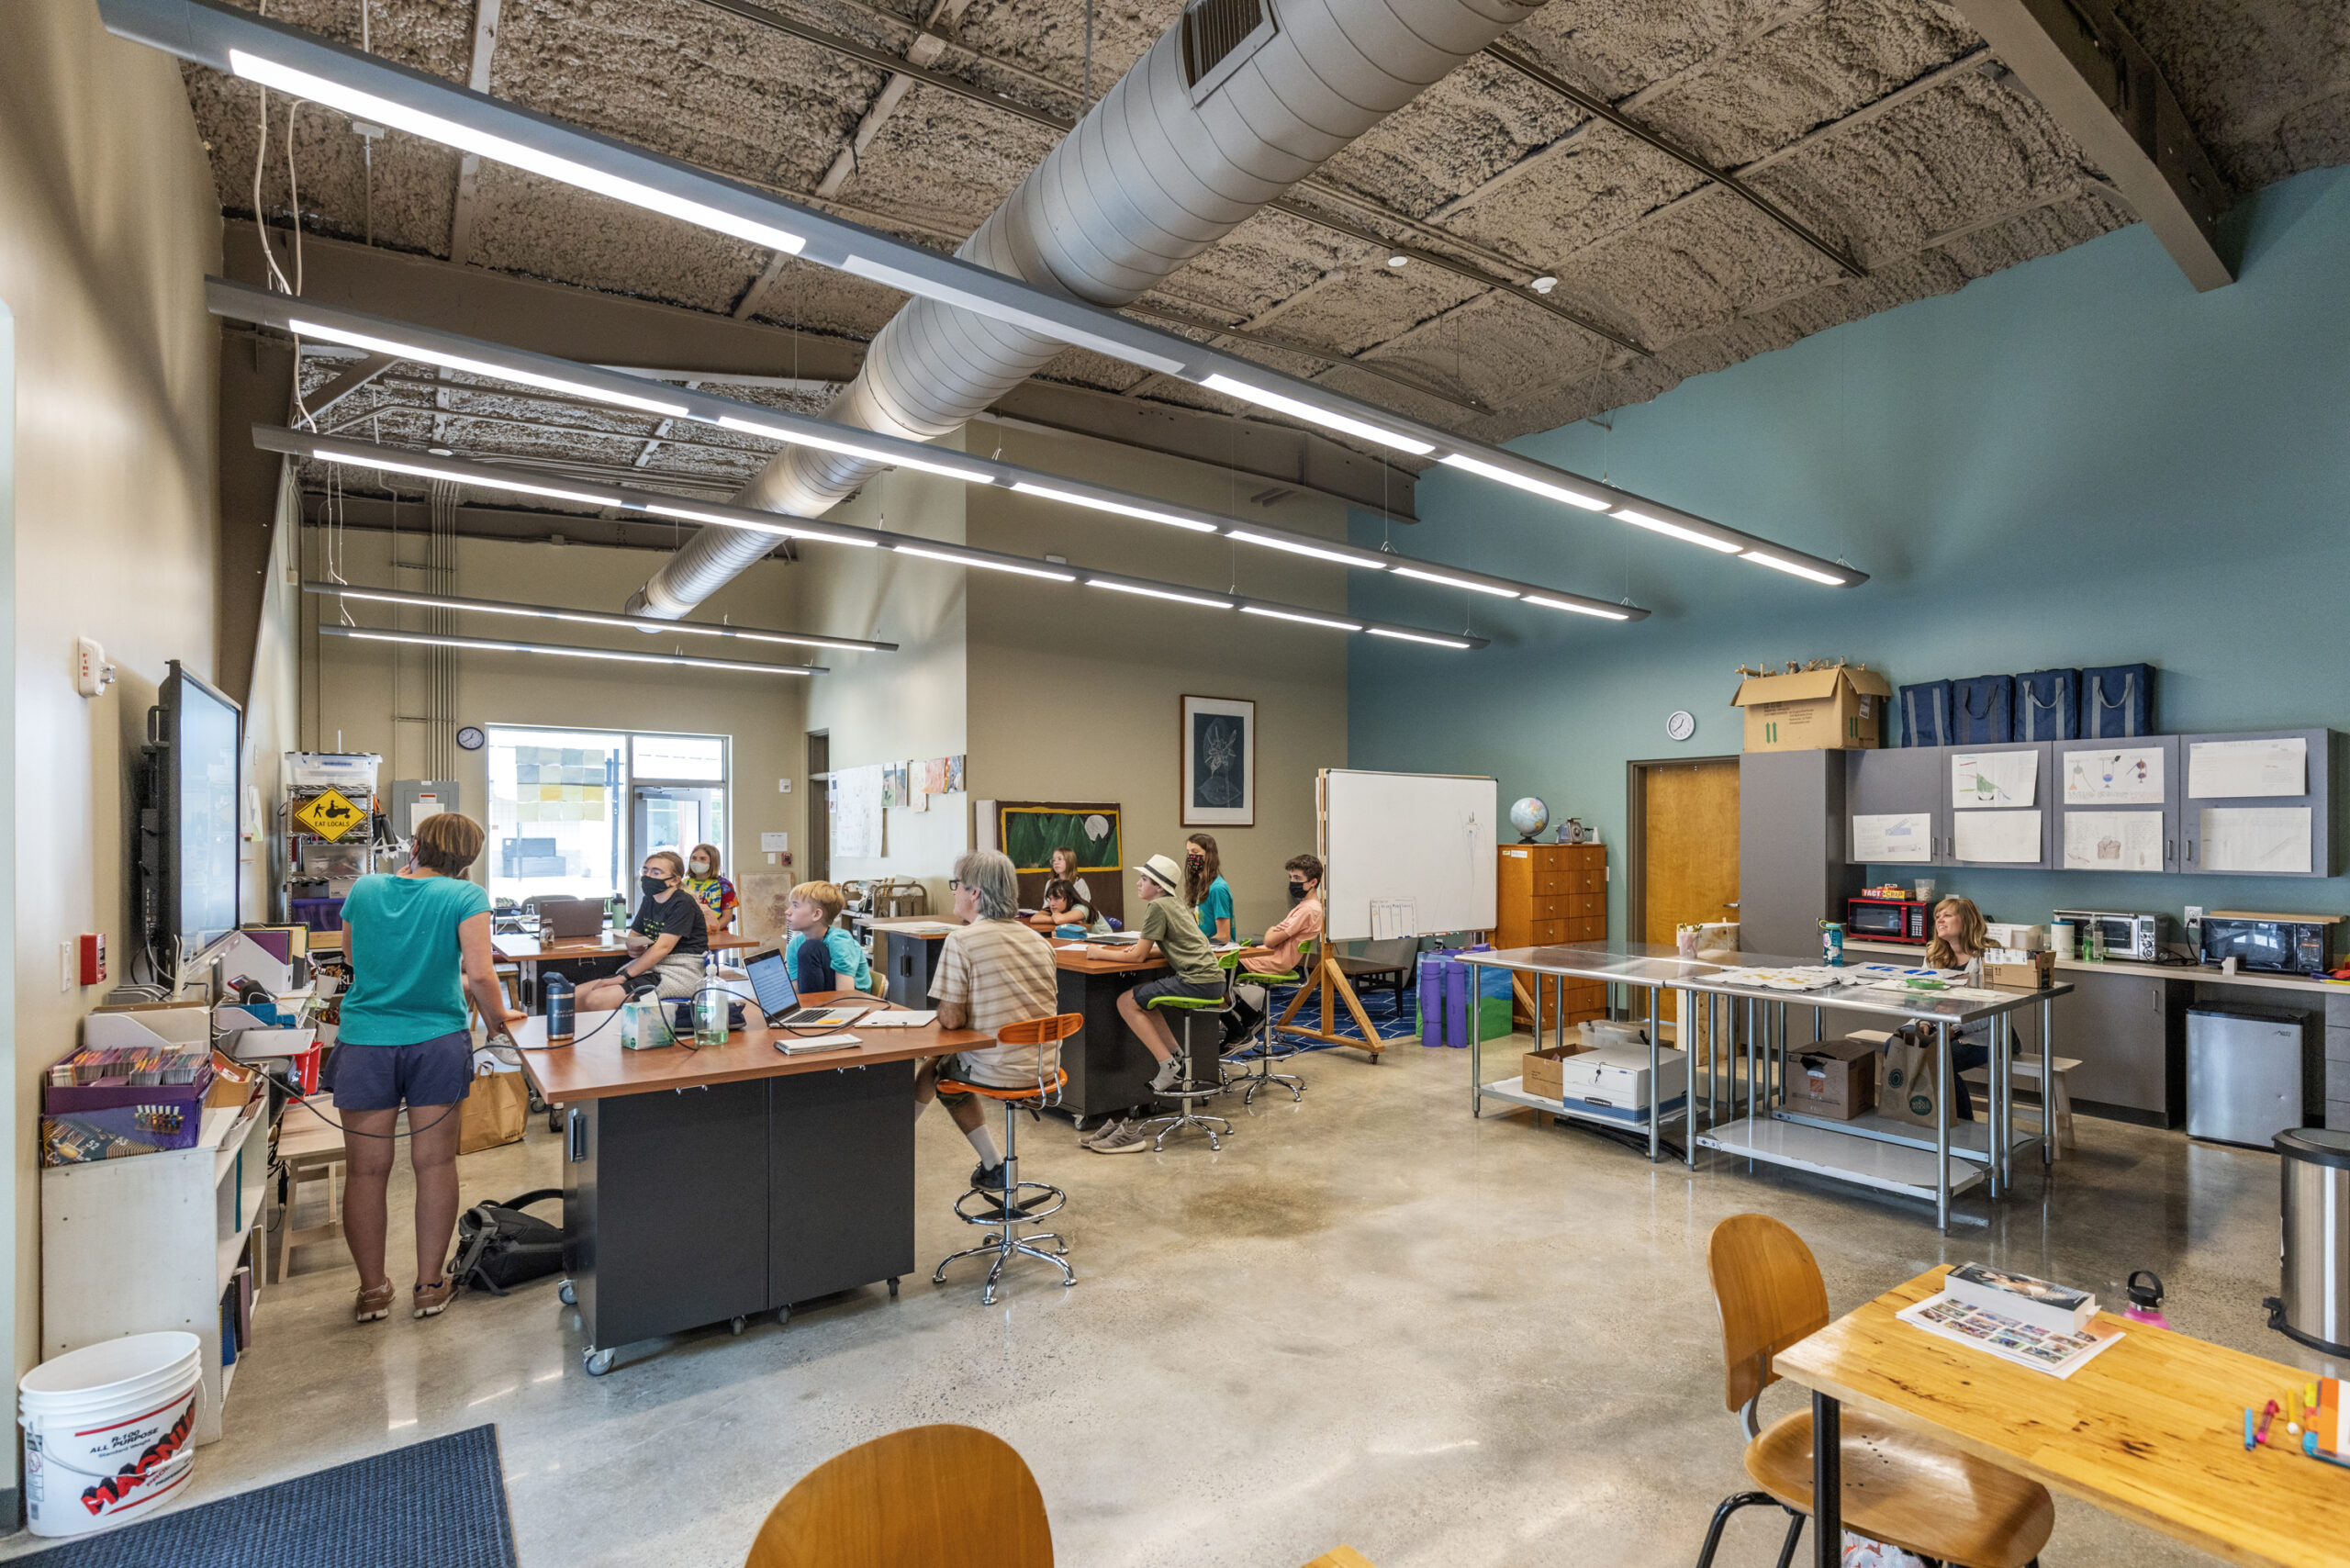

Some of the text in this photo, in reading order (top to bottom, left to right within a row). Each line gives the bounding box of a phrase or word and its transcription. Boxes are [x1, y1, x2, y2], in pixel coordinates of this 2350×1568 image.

[1863, 889, 1881, 897] FACT
[85, 1139, 100, 1150] 52
[90, 1427, 159, 1453] ALL PURPOSE
[111, 1429, 140, 1443] R-100
[81, 1396, 196, 1516] MAGNU
